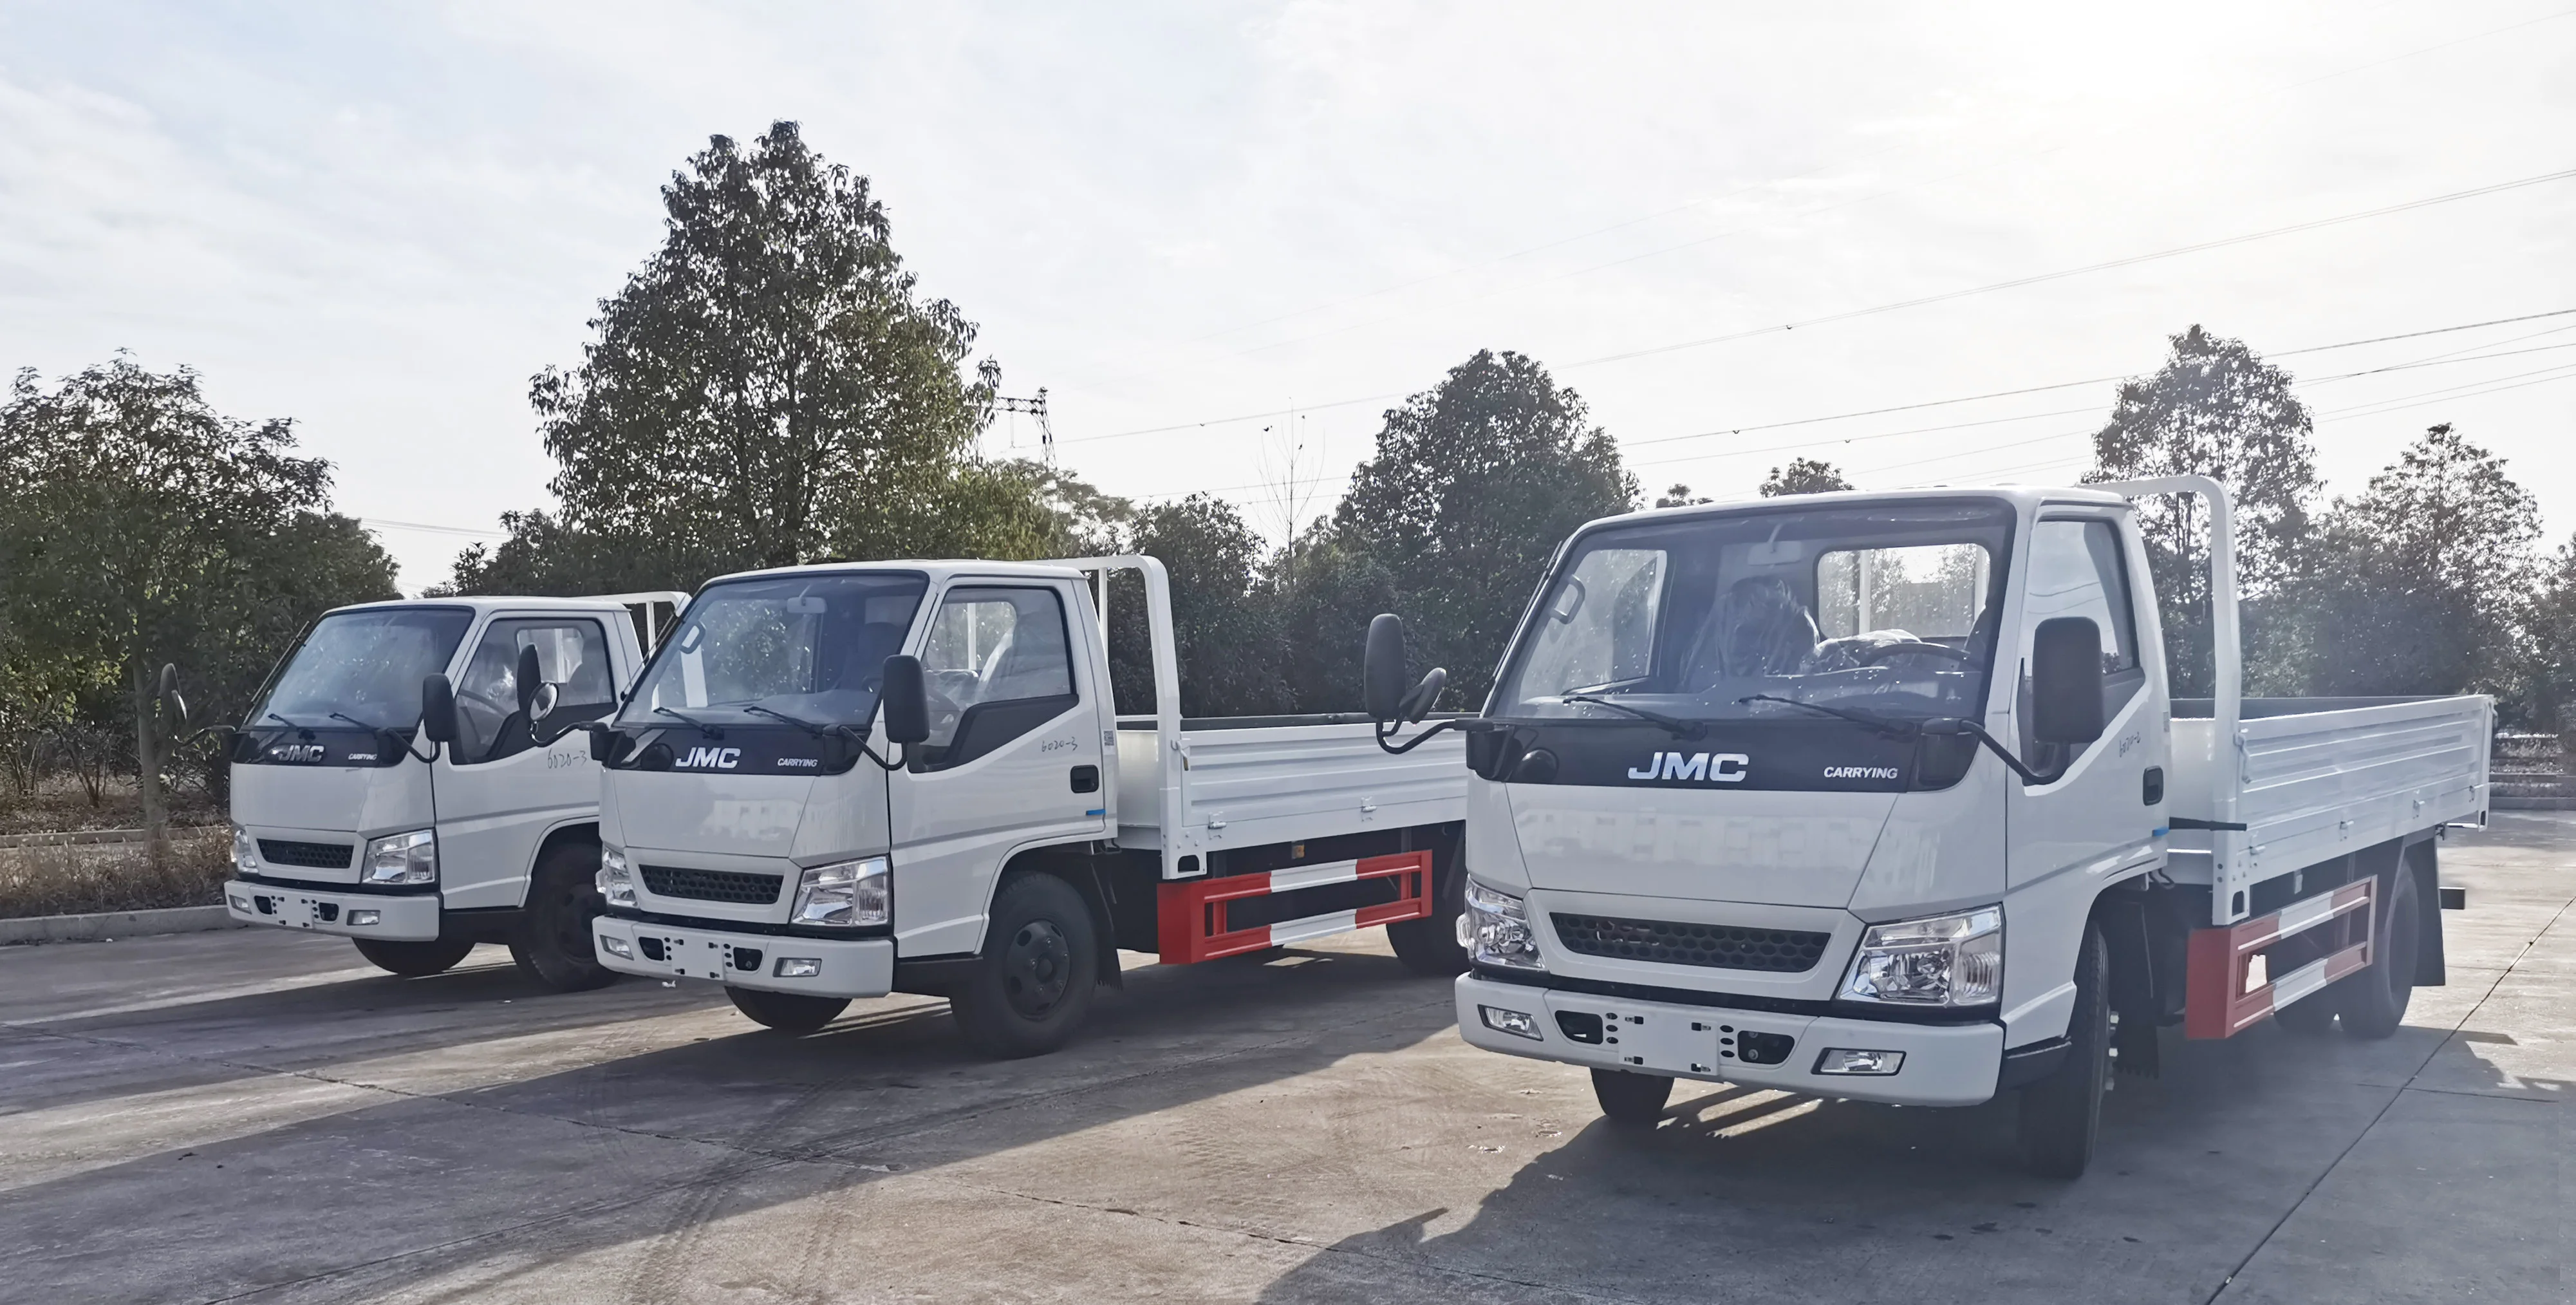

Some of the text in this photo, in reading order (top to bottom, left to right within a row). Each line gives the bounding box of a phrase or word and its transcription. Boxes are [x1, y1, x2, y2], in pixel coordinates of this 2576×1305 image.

[1041, 736, 1078, 752] 6020-3
[278, 745, 324, 762] JMC
[548, 747, 587, 769] 6020-3
[675, 747, 741, 769] JMC
[778, 758, 818, 767] CARRYING
[1628, 751, 1750, 782] JMC
[1824, 766, 1898, 779] CARRYING
